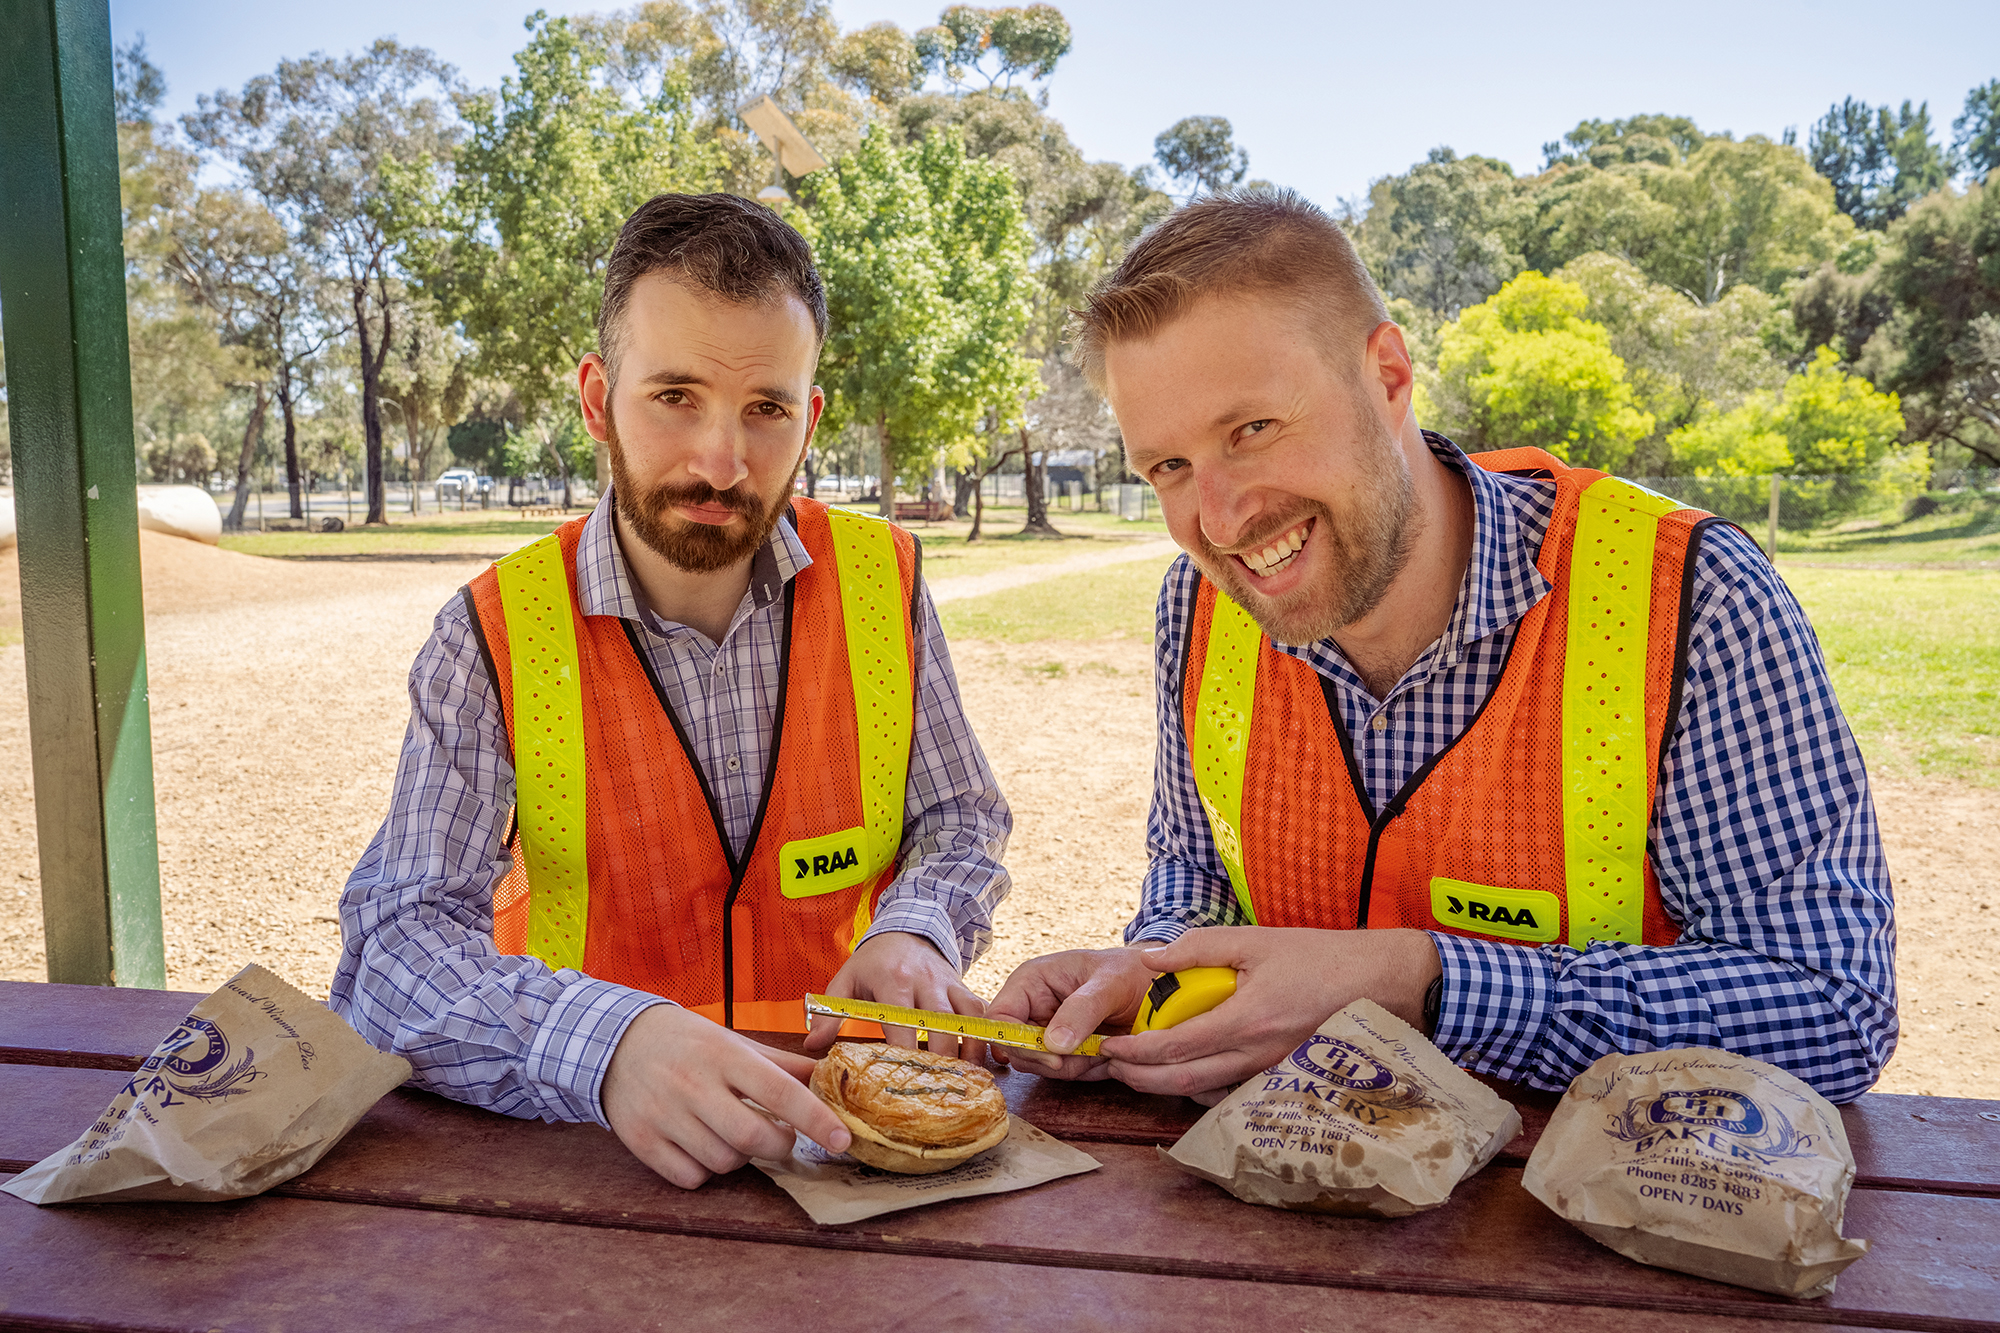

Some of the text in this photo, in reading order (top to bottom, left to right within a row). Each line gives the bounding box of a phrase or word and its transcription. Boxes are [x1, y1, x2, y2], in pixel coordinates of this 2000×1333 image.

[813, 847, 859, 876] RAA
[1468, 900, 1539, 929] RAA
[200, 1022, 222, 1055] HILLS
[262, 1000, 300, 1039] Winning
[297, 1040, 318, 1071] Pies
[918, 1019, 926, 1028] 3
[957, 1025, 965, 1034] 4
[997, 1030, 1005, 1040] 5
[1035, 1036, 1043, 1045] 6
[1343, 1010, 1400, 1045] Award
[1309, 1036, 1348, 1049] PARA
[1297, 1056, 1375, 1089] HOT BREAD
[1250, 1109, 1273, 1119] Para
[1276, 1111, 1302, 1121] Hills
[1262, 1077, 1389, 1126] BAKERY
[1281, 1100, 1304, 1109] 513
[1306, 1103, 1344, 1125] Bridge
[1244, 1121, 1351, 1143] Phone: 8285 1883
[1252, 1136, 1334, 1156] OPEN 7 DAYS
[1634, 1127, 1778, 1166] BAKERY
[1627, 1165, 1761, 1200] Phone: 8285 1883
[1663, 1156, 1696, 1168] Hills
[1700, 1160, 1720, 1174] SA
[1724, 1167, 1762, 1184] 5096
[1639, 1184, 1744, 1217] OPEN 7 DAYS
